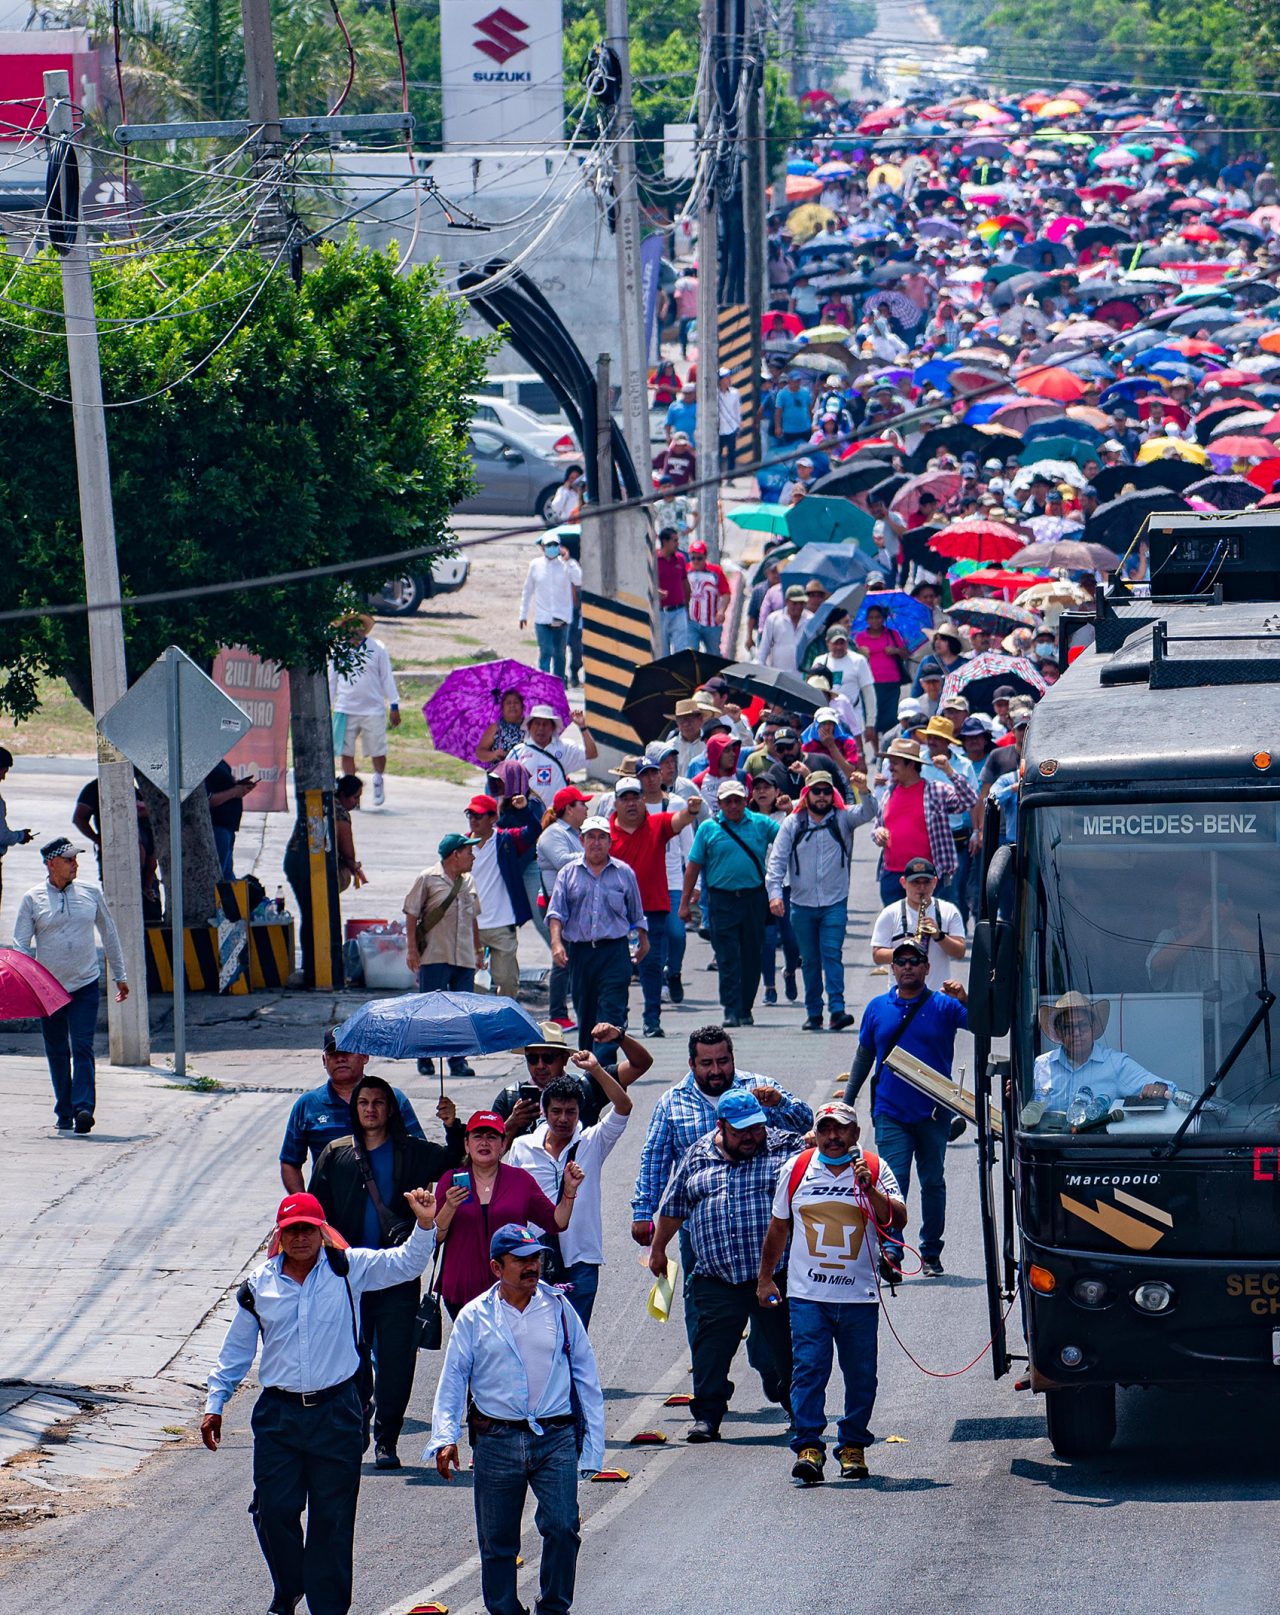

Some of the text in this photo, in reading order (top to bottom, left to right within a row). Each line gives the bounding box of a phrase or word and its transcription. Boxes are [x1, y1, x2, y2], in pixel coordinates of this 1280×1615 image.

[473, 71, 531, 82] SUZUKI
[1083, 814, 1257, 835] MERCEDES-BENZ
[1069, 1175, 1159, 1186] Marcopolo
[810, 1186, 861, 1197] DHL
[828, 1275, 856, 1286] Mifel
